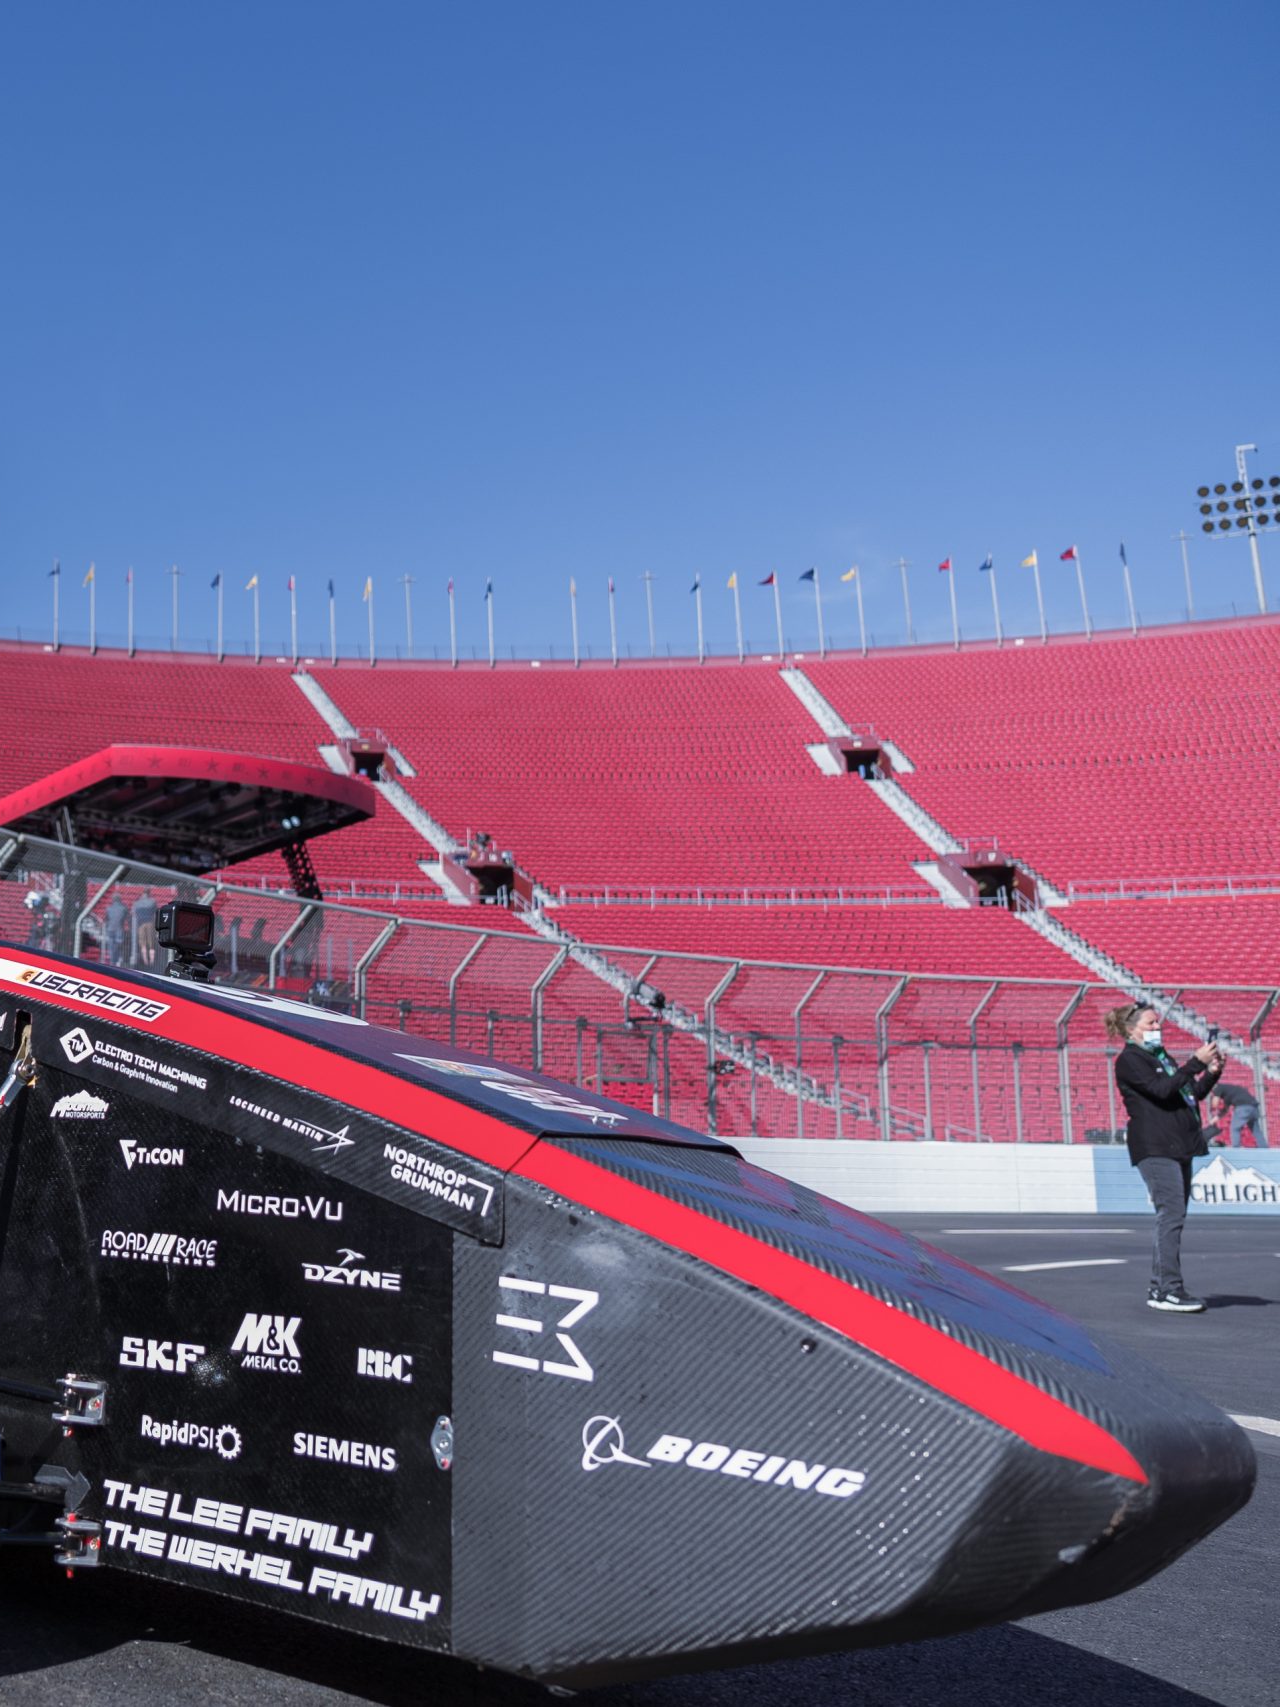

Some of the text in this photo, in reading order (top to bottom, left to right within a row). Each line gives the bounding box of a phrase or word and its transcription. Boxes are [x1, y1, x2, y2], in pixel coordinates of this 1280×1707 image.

[92, 1054, 114, 1069] Carbon
[119, 1064, 145, 1082] Graphite
[145, 1073, 179, 1092] Innovation
[94, 1040, 208, 1090] ELECTRO TECH MACHINING
[65, 1111, 106, 1119] MOTORSPORTS
[229, 1095, 324, 1142] LOCKHEED MARTIN
[383, 1143, 469, 1188] NORTHROP
[390, 1164, 475, 1211] GRUMMAN
[101, 1230, 218, 1259] ROAD RACE
[101, 1249, 216, 1267] ENGINEERING
[301, 1262, 402, 1292] DZYNE
[119, 1336, 205, 1373] SKF
[231, 1313, 302, 1358] M&K
[241, 1355, 302, 1374] METAL CO.
[357, 1347, 412, 1383] RBC
[293, 1432, 397, 1471] SIEMENS
[647, 1433, 866, 1498] BOEING
[102, 1479, 374, 1560] THE LEE FAMILY
[104, 1520, 442, 1621] THE WERHEL FAMILY
